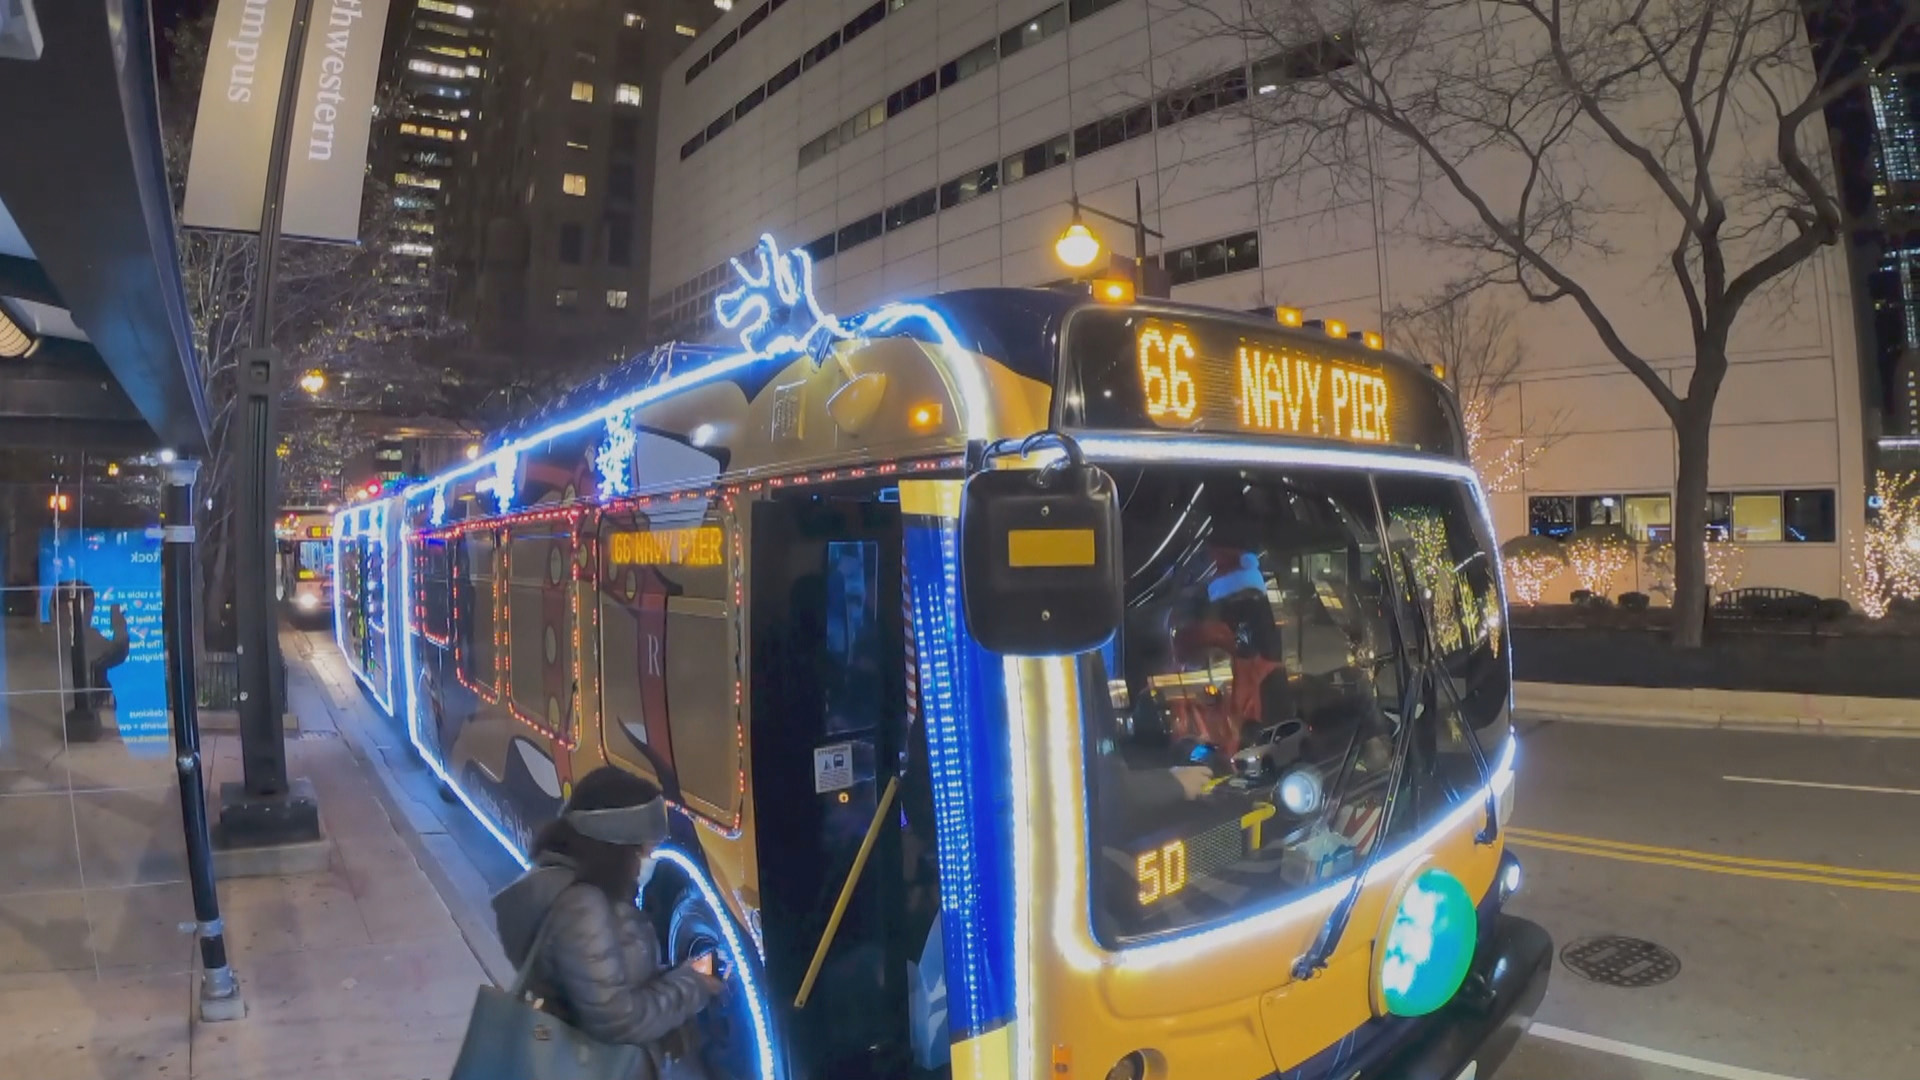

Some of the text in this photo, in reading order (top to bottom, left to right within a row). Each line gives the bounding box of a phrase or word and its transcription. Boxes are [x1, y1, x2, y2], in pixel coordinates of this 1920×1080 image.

[228, 0, 268, 103] mpus
[1138, 326, 1390, 442] 66 NAVY PIER
[614, 527, 723, 565] 66 NAVY PIER
